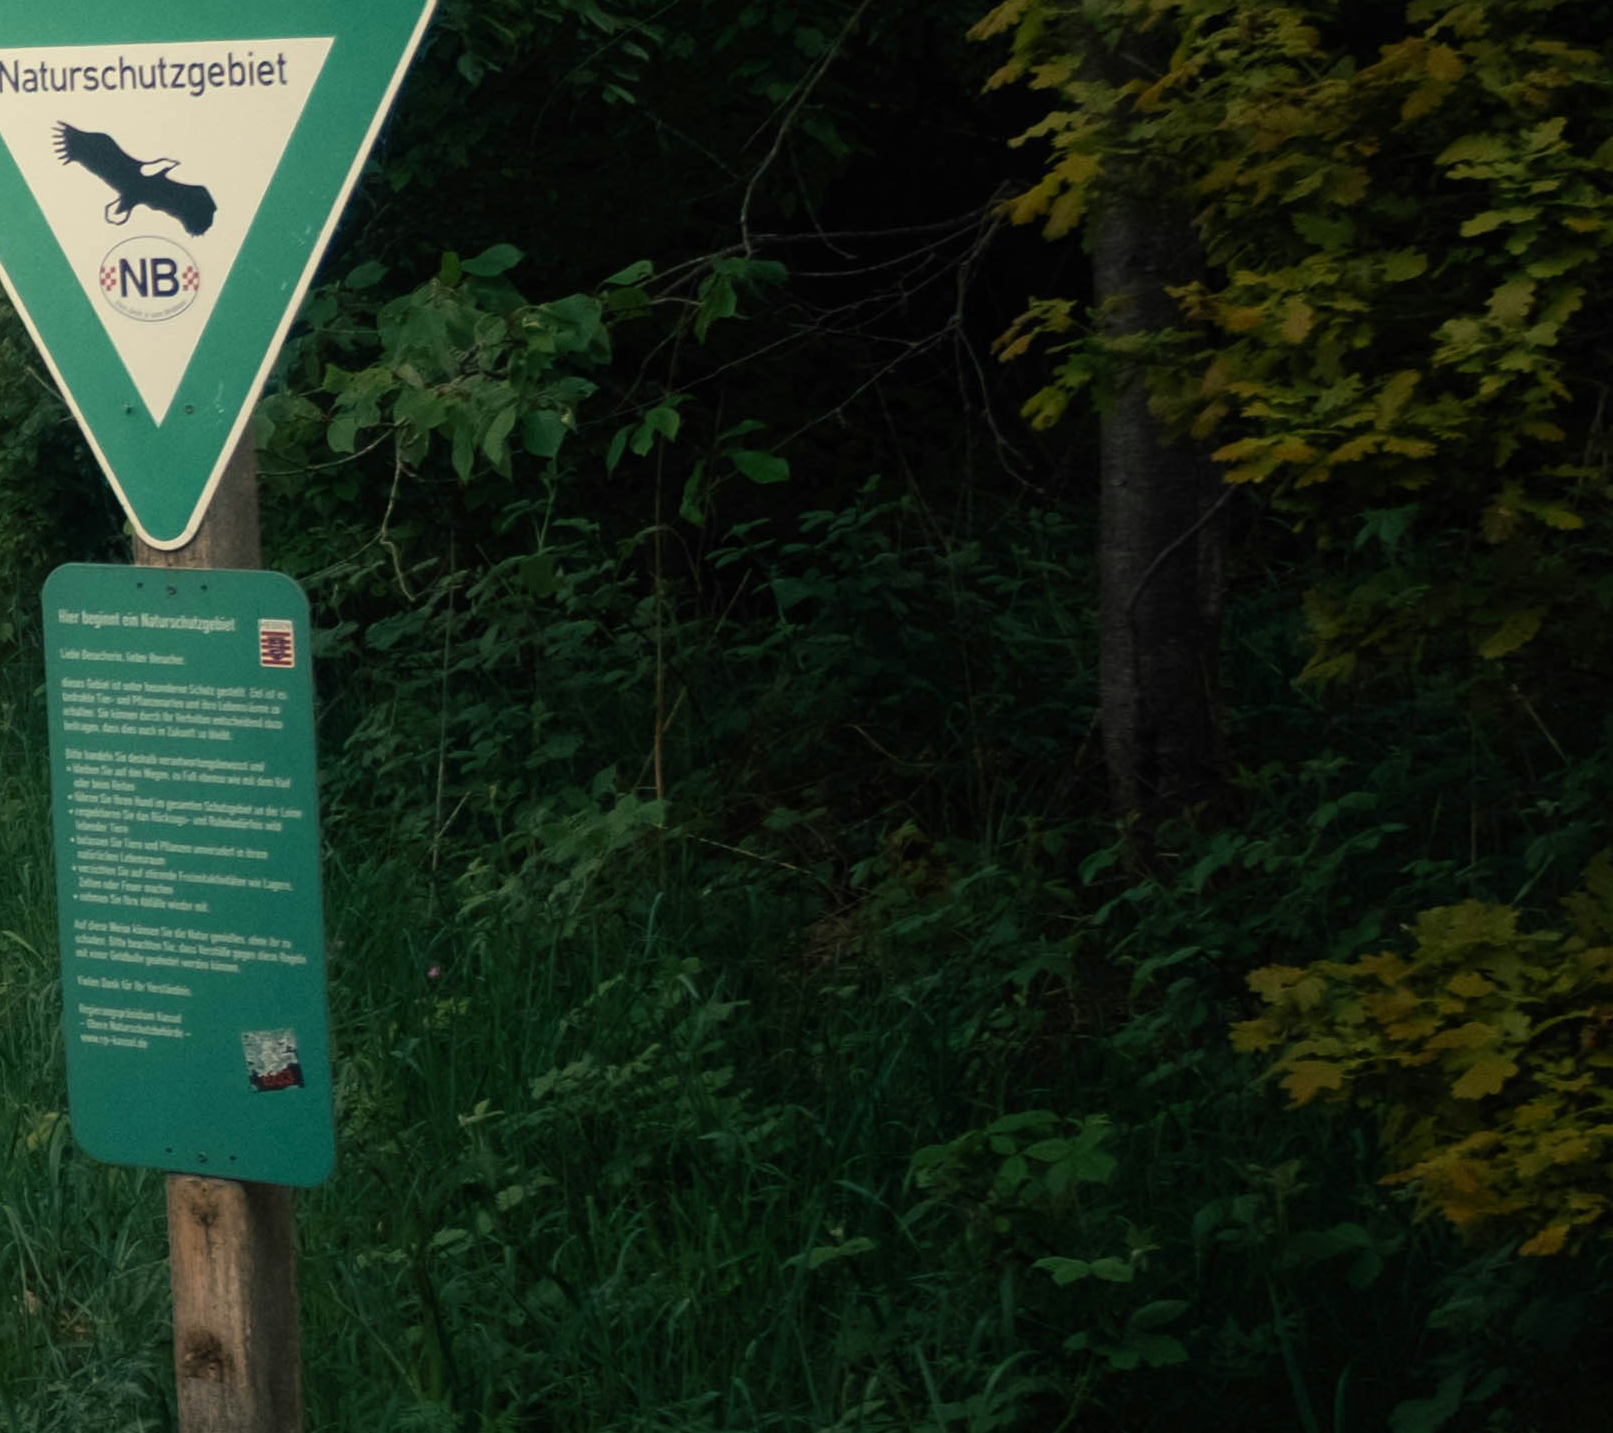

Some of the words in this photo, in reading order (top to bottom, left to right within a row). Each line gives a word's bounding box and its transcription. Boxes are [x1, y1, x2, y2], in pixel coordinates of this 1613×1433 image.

[119, 257, 180, 298] NB
[58, 609, 79, 624] Hier
[81, 610, 120, 629] beginnt
[122, 612, 139, 627] ein
[141, 613, 236, 635] Naturschutzgebiet
